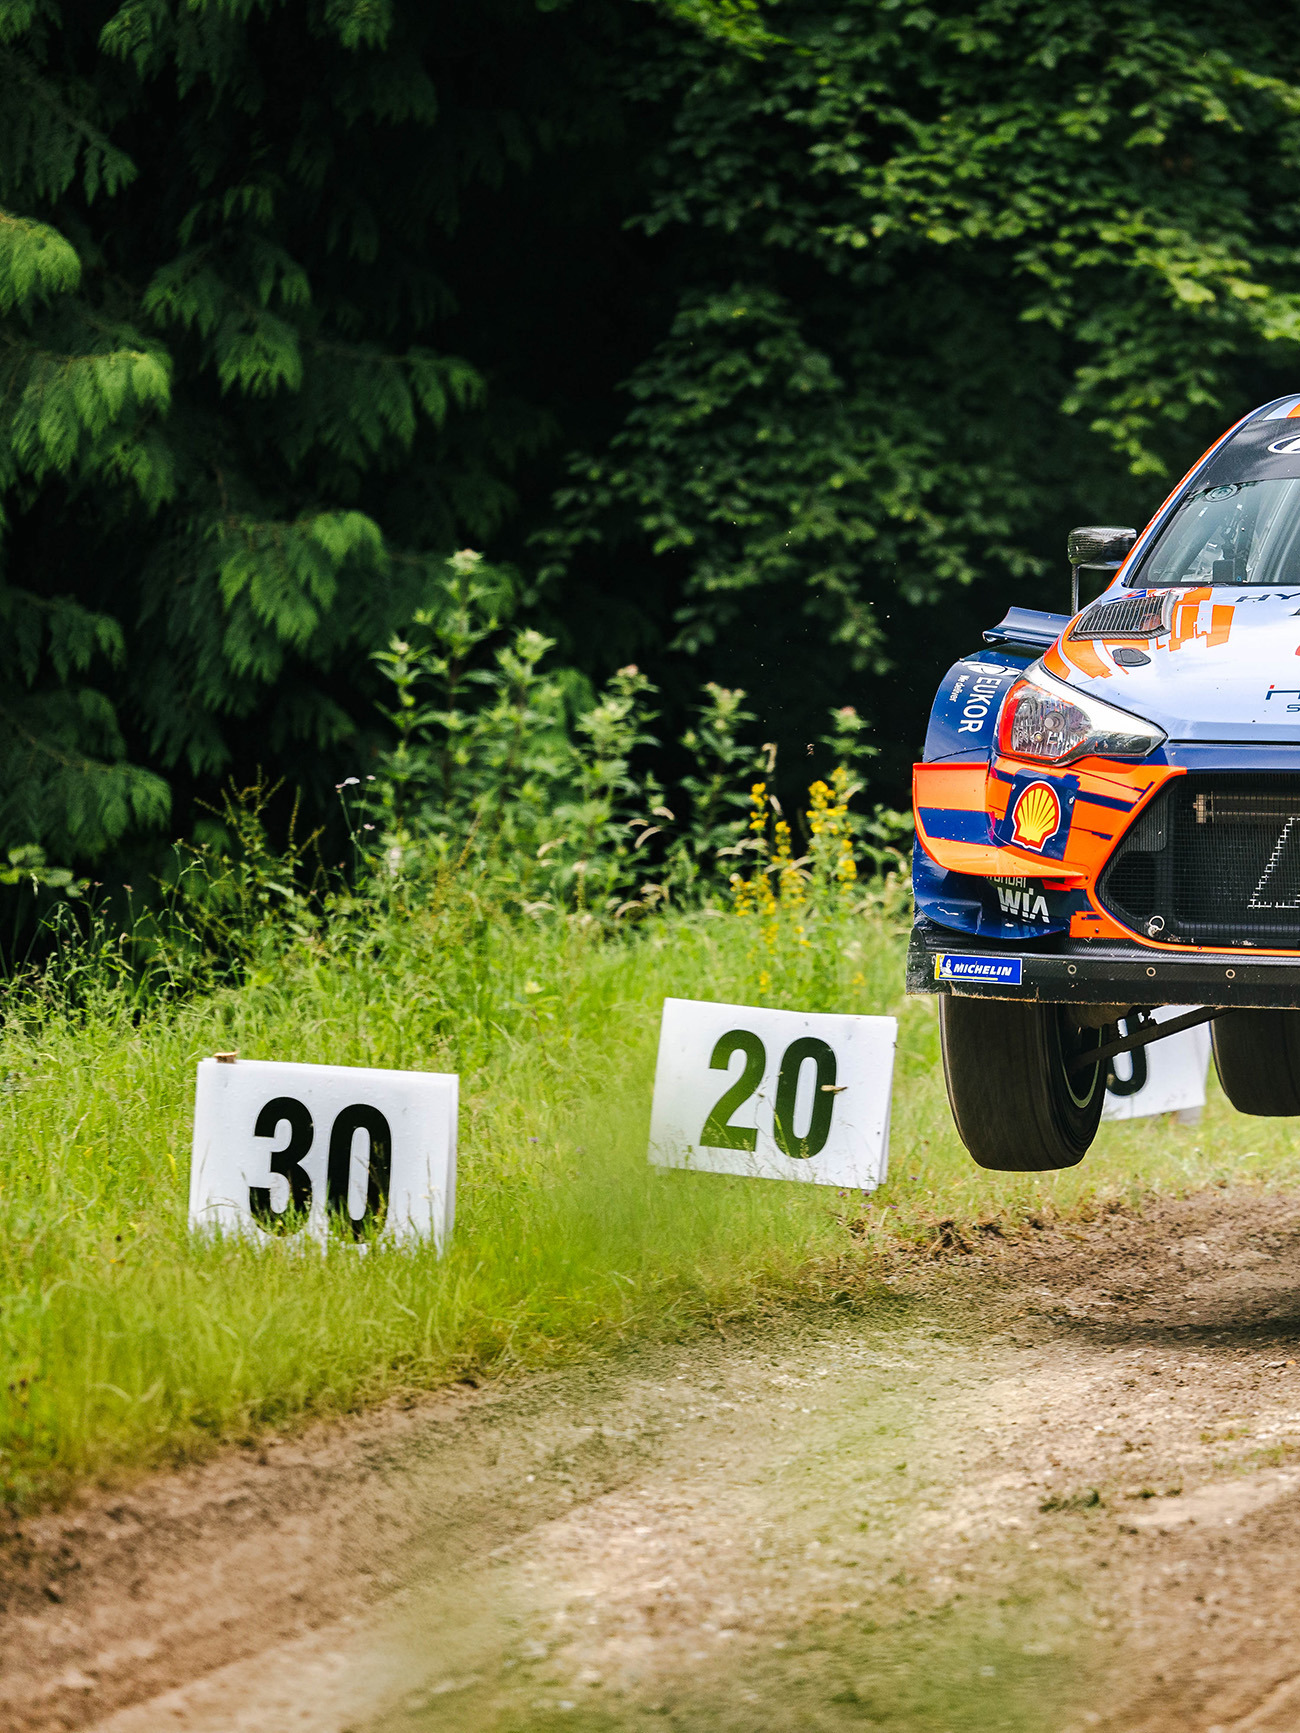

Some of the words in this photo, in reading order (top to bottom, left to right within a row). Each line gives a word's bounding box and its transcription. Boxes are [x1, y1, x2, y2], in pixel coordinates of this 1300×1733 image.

[957, 676, 1003, 734] EUKOR
[997, 886, 1050, 924] WIA
[953, 963, 1013, 977] MICHELIN
[700, 1029, 837, 1160] 20
[248, 1096, 393, 1244] 30
